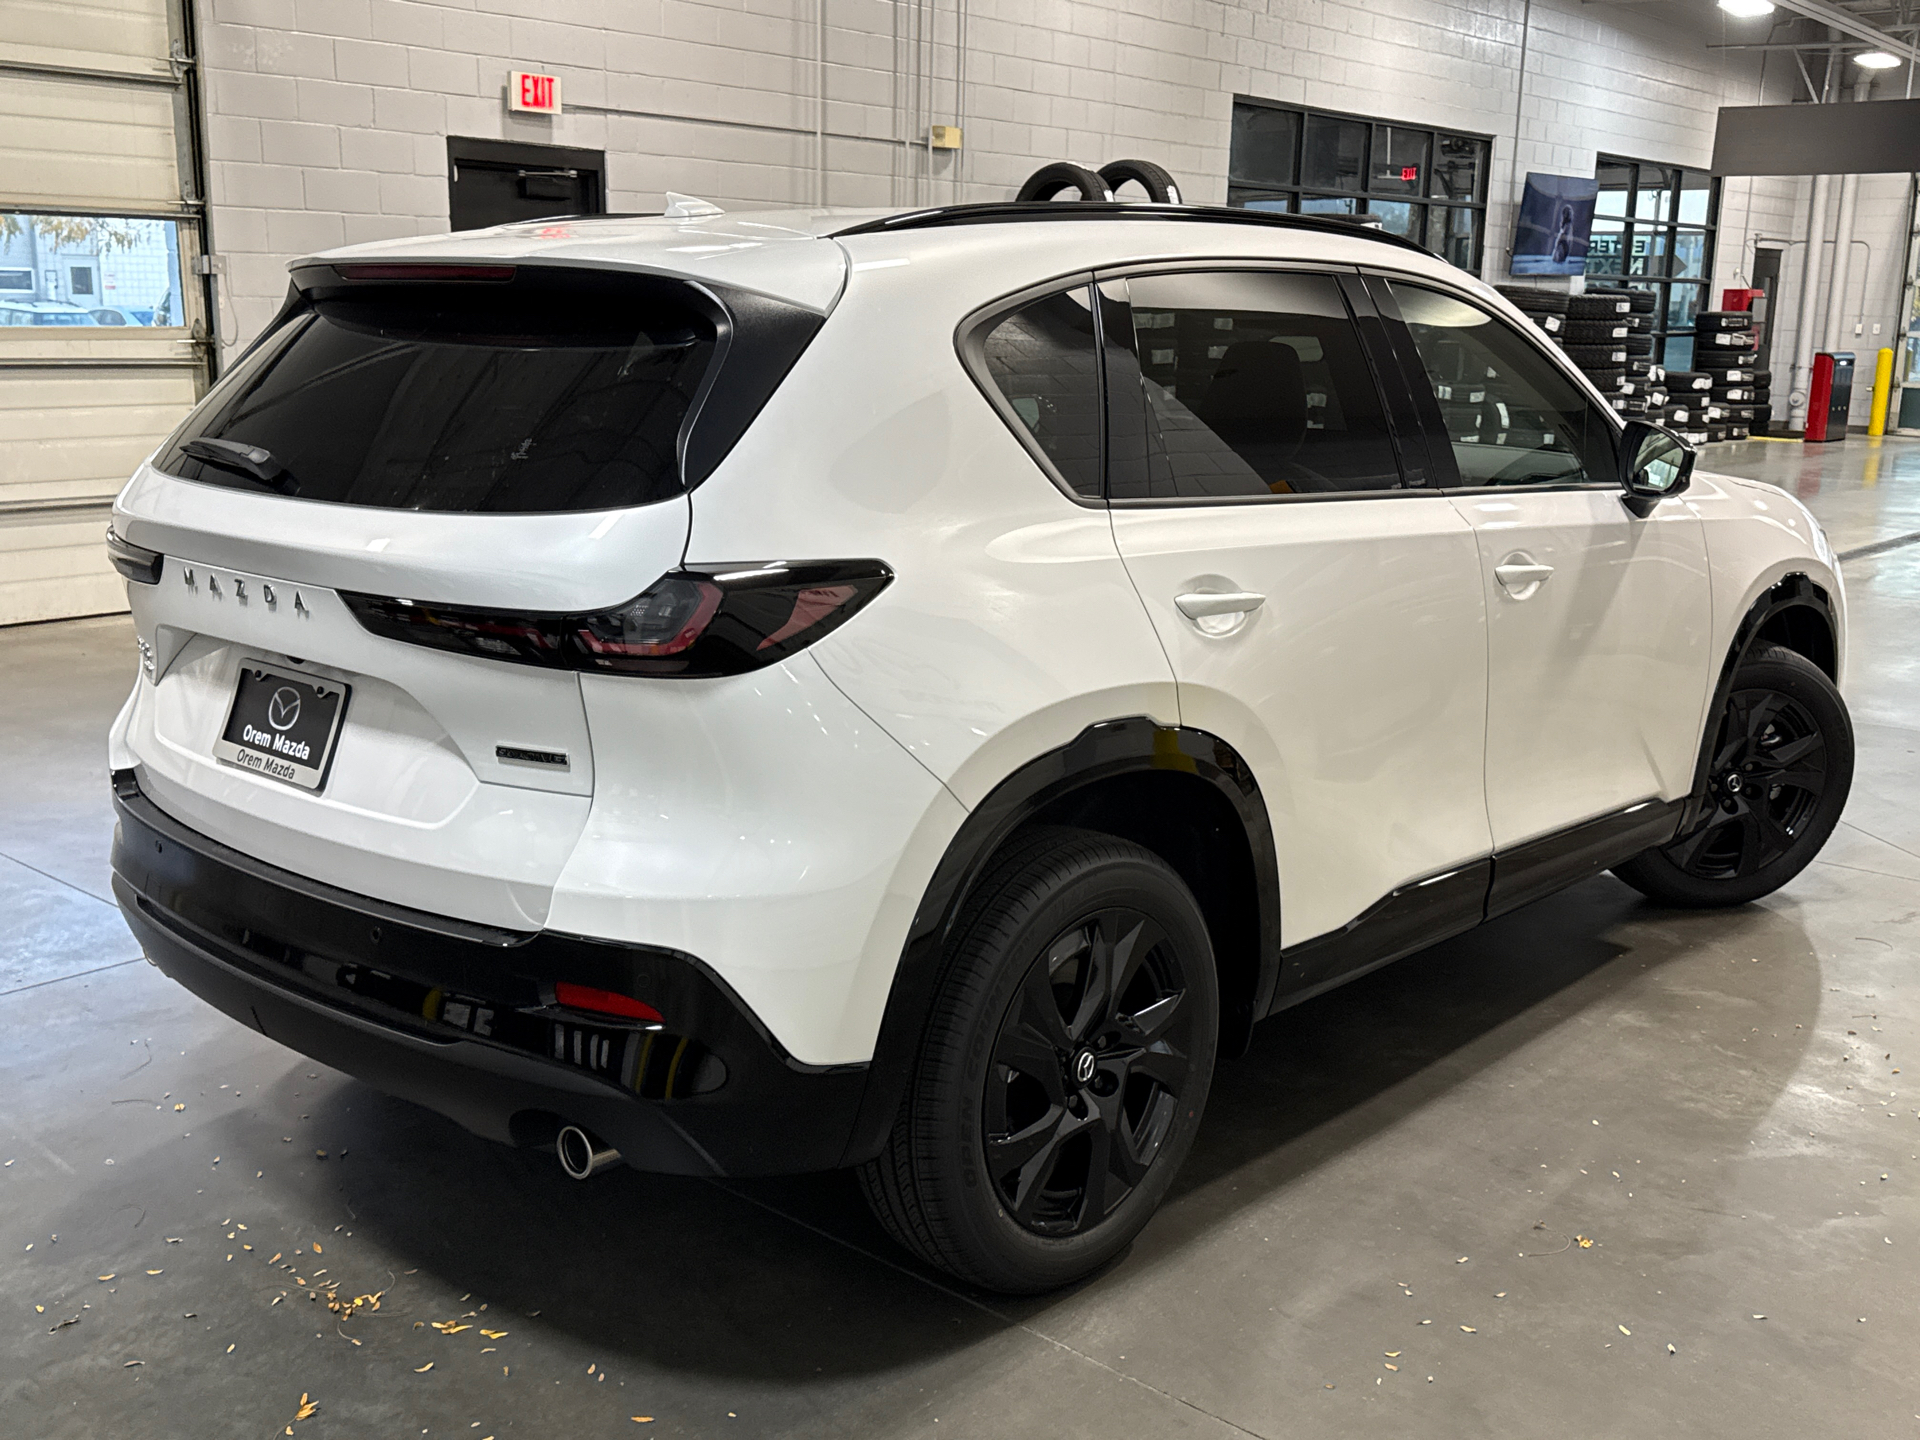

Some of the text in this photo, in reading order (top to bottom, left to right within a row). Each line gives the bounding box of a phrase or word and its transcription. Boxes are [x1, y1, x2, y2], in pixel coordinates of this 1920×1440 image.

[521, 74, 554, 109] EXIT
[183, 566, 309, 612] MAZDA
[243, 724, 311, 760] Orem Mazda
[236, 748, 295, 779] Orem Mazda
